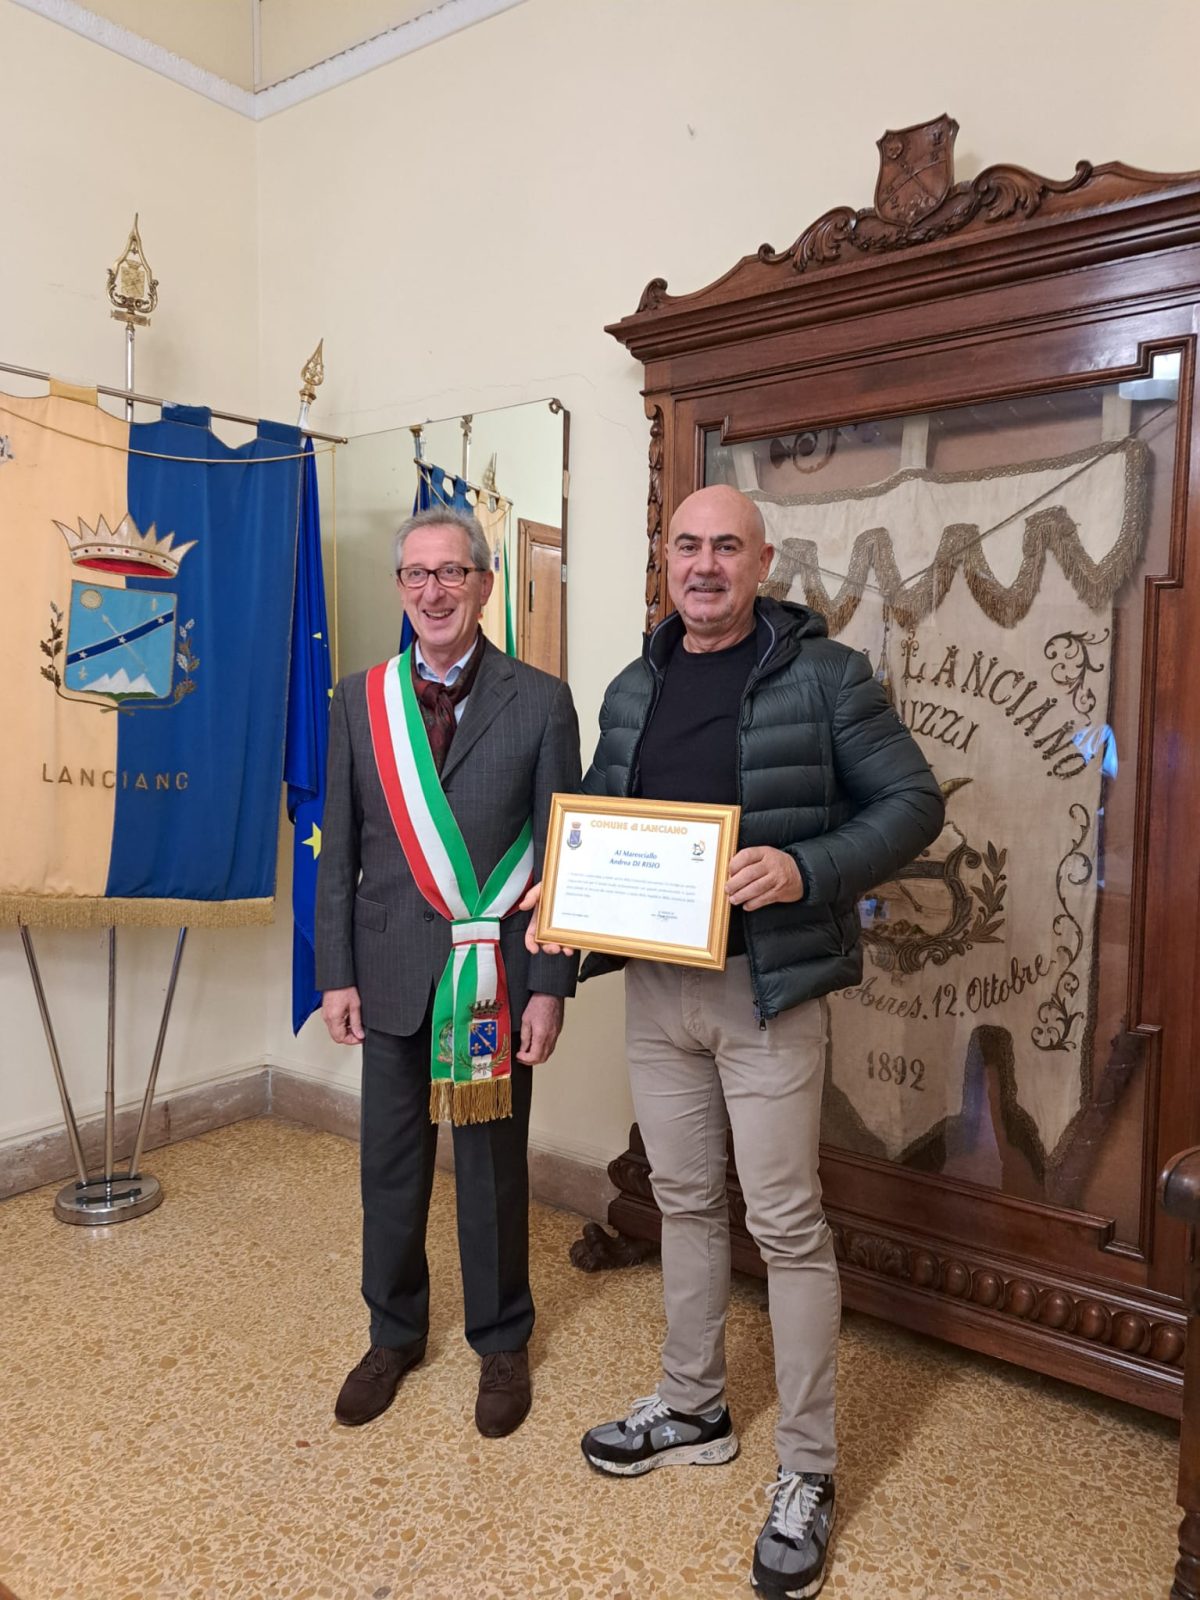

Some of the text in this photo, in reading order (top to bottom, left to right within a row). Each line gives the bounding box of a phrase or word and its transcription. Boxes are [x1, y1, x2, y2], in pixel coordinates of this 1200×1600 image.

[900, 637, 1094, 780] LANCIANO
[590, 819, 689, 835] COMUNE di LANCIANO
[622, 850, 658, 860] Maresciallo
[609, 858, 661, 869] Andrea DI RISIO
[867, 1050, 926, 1092] 1892
